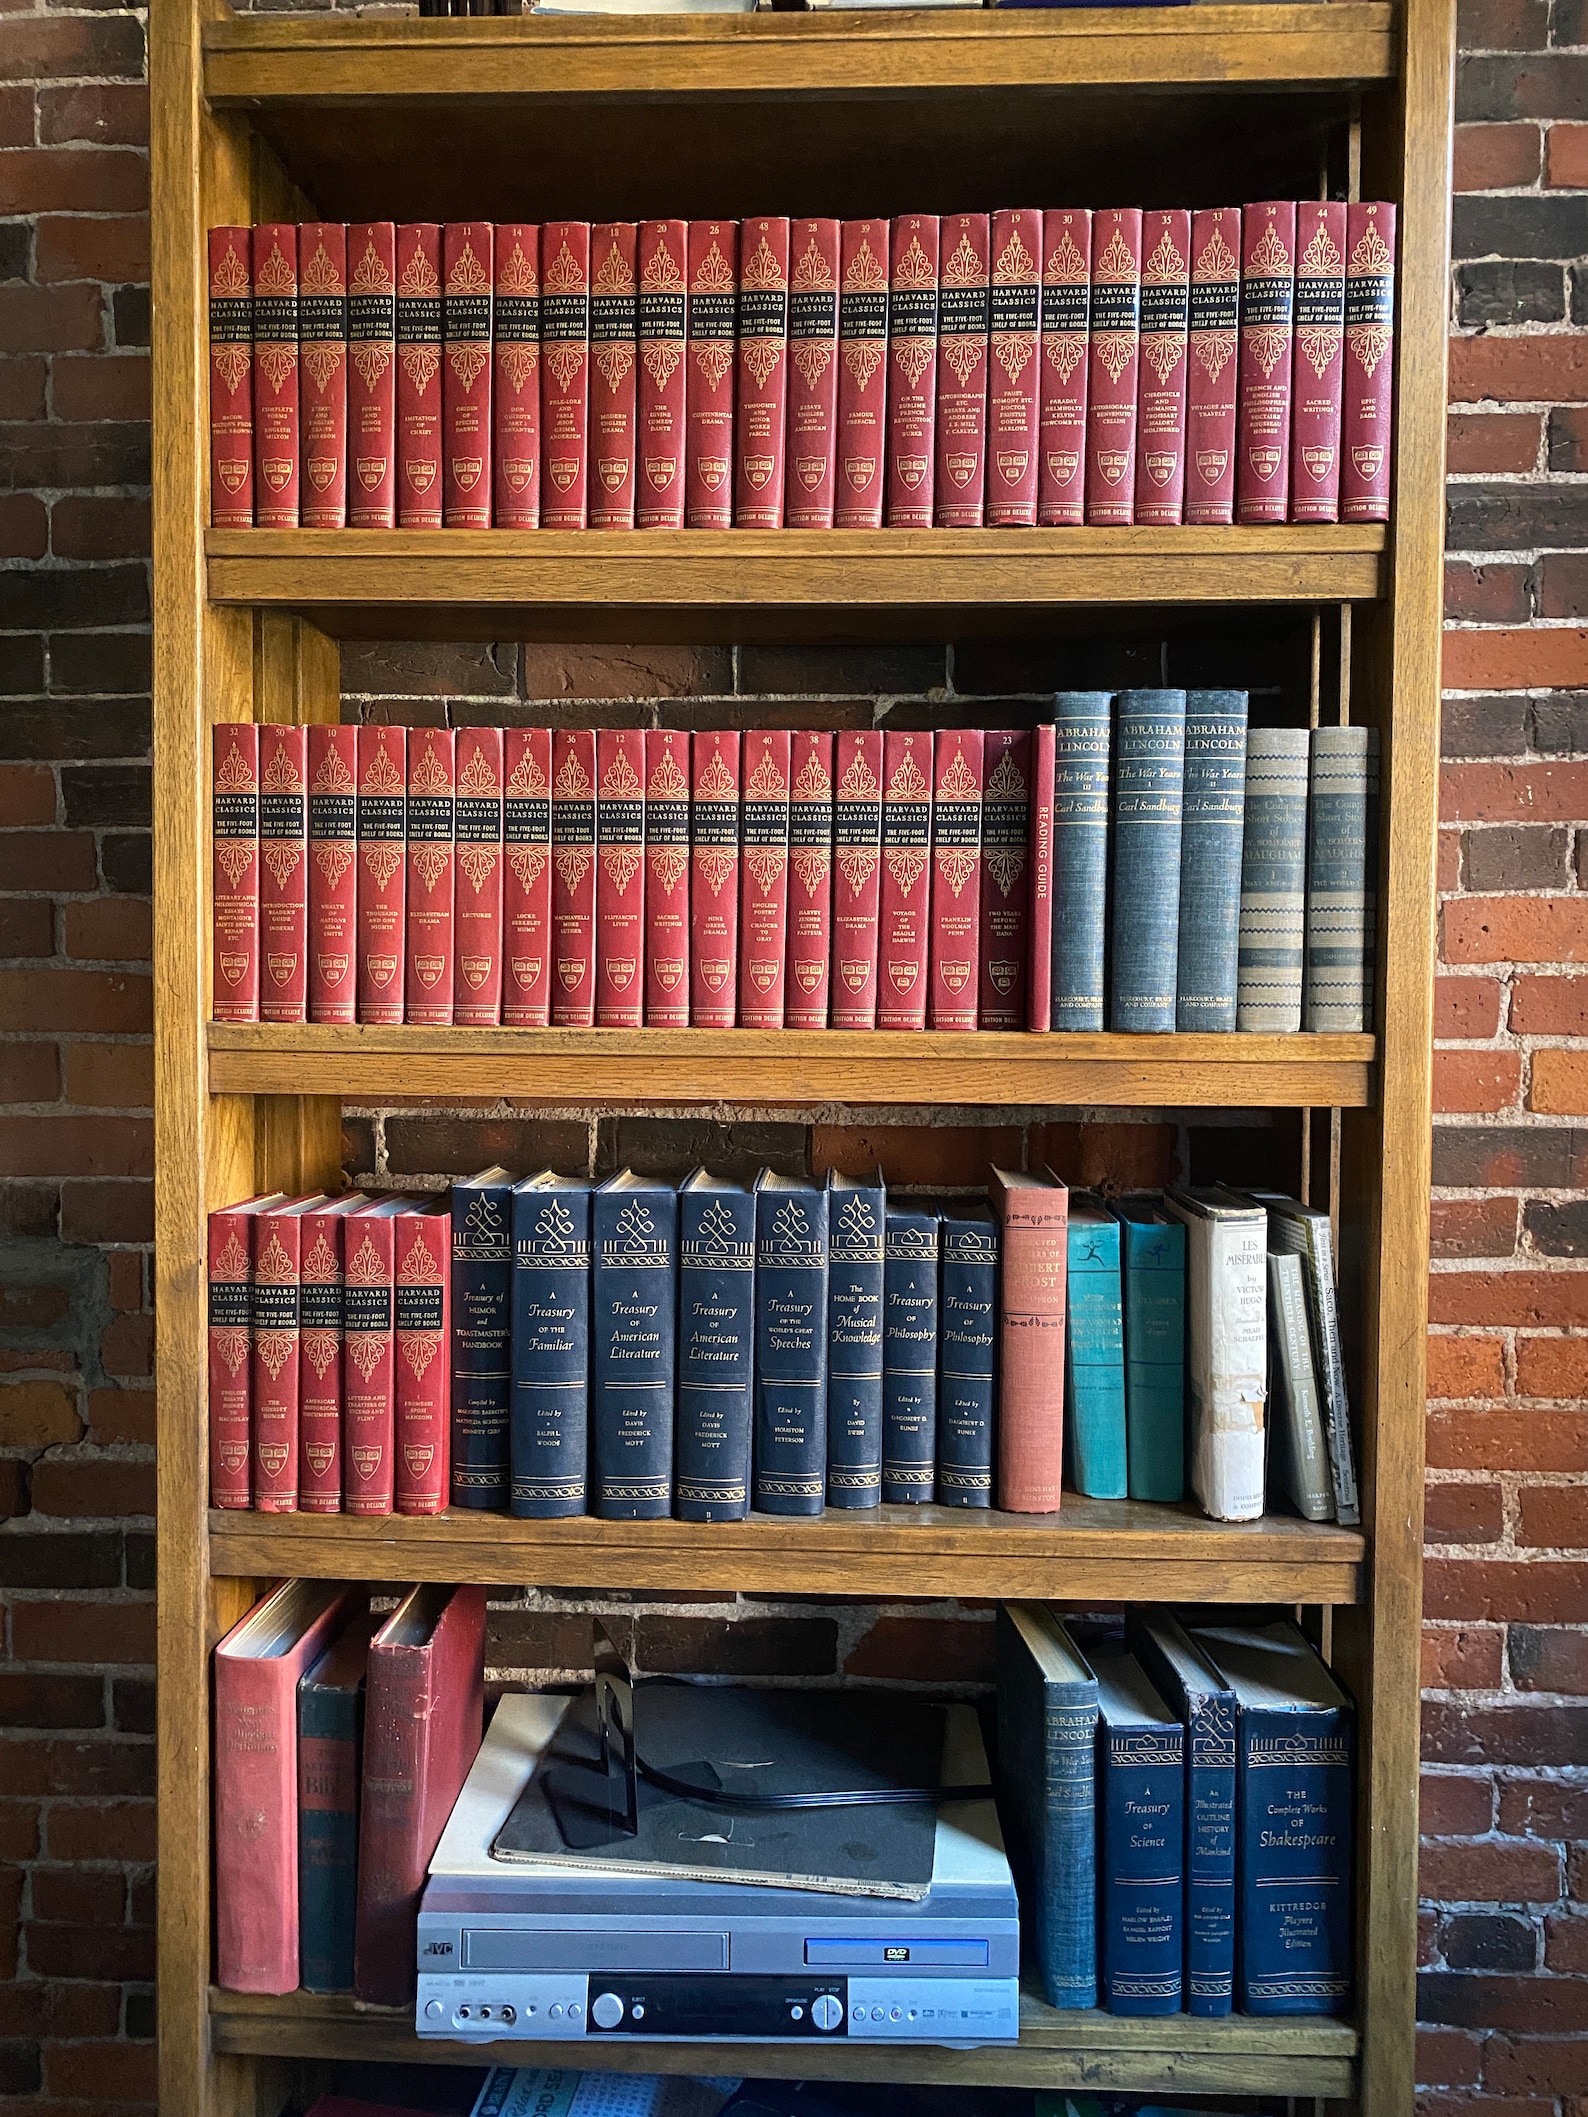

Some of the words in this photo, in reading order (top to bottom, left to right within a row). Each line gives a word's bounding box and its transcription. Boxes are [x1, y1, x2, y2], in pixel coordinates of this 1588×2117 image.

[1011, 214, 1020, 222] 19
[1212, 212, 1222, 221] 33
[960, 218, 969, 227] 25
[368, 227, 373, 236] 6
[513, 228, 522, 236] 14
[710, 226, 719, 235] 26
[1193, 286, 1237, 294] HARVARD
[942, 291, 985, 299] HARVARD
[1192, 295, 1237, 304] CLASSICS
[351, 299, 391, 307] HARVARD
[497, 299, 538, 307] HARVARD
[693, 298, 734, 306] HARVARD
[942, 300, 985, 308] CLASSICS
[992, 298, 1035, 306] CLASSICS
[351, 307, 391, 315] CLASSICS
[496, 308, 538, 316] CLASSICS
[692, 307, 734, 315] CLASSICS
[230, 728, 238, 736] 32
[1123, 726, 1182, 737] ABRAHAM
[1186, 726, 1245, 736] ABRAHAM
[522, 734, 532, 742] 37
[763, 736, 772, 745] 40
[904, 737, 914, 746] 29
[958, 736, 961, 744] 1
[1124, 740, 1180, 750] LINCOLN
[1186, 739, 1243, 750] LINCOLN
[1057, 772, 1072, 782] The
[1075, 772, 1094, 782] War
[1120, 768, 1136, 779] The
[1138, 769, 1155, 779] War
[1158, 768, 1181, 779] Years
[507, 802, 547, 810] HARVARD
[1055, 803, 1073, 813] Carl
[1119, 801, 1137, 811] Carl
[1140, 801, 1179, 813] Sandburg
[1203, 801, 1243, 813] Sandburg
[506, 811, 548, 819] CLASSICS
[745, 813, 786, 821] CLASSICS
[886, 814, 927, 822] CLASSICS
[936, 814, 978, 822] CLASSICS
[1039, 807, 1049, 858] READING
[1038, 864, 1047, 899] GUIDE
[365, 1222, 370, 1231] 9
[415, 1221, 424, 1230] 21
[1243, 1240, 1258, 1251] LES
[1247, 1275, 1257, 1284] by
[398, 1289, 440, 1297] HARVARD
[850, 1285, 863, 1293] The
[345, 1298, 388, 1306] CLASSICS
[463, 1292, 494, 1303] Treasury
[496, 1292, 503, 1303] of
[834, 1295, 855, 1303] HOME
[889, 1294, 933, 1308] Treasury
[1240, 1296, 1262, 1305] HUGO
[1325, 1288, 1335, 1315] Saco,
[612, 1302, 658, 1316] Treasury
[768, 1300, 813, 1315] Treasury
[853, 1305, 860, 1314] of
[947, 1297, 993, 1313] Treasury
[528, 1304, 575, 1320] Treasury
[692, 1303, 737, 1317] Treasury
[837, 1316, 876, 1328] Musical
[1283, 1270, 1293, 1322] TWENTIETH
[1289, 1327, 1300, 1370] CENTURY
[456, 1329, 510, 1337] TOASTMASTER'S
[886, 1327, 934, 1341] Philosophy
[1294, 1290, 1304, 1331] MEANING
[1302, 1352, 1310, 1370] THE
[1328, 1317, 1337, 1343] Then
[611, 1330, 659, 1342] American
[691, 1332, 738, 1344] American
[832, 1330, 881, 1344] Knowledge
[944, 1329, 993, 1345] Philosophy
[528, 1338, 574, 1351] Familiar
[770, 1337, 811, 1350] Speeches
[610, 1346, 661, 1359] Literature
[689, 1348, 739, 1361] Literature
[1331, 1346, 1340, 1364] and
[1287, 1791, 1306, 1799] THE
[1125, 1802, 1170, 1816] Treasury
[1195, 1800, 1232, 1810] Illustrated
[1268, 1804, 1300, 1816] Complete
[1302, 1804, 1327, 1814] Works
[1291, 1819, 1304, 1827] OF
[1198, 1825, 1229, 1833] HISTORY
[1130, 1835, 1165, 1848] Science
[1210, 1836, 1217, 1845] of
[1260, 1832, 1336, 1848] Shakespeare
[1196, 1847, 1231, 1857] Mankind
[1269, 1903, 1326, 1912] KITTREDGE
[1284, 1916, 1313, 1926] Players
[1279, 1927, 1318, 1937] Illustrated
[1285, 1939, 1312, 1948] Edition
[424, 1943, 453, 1955] JVC
